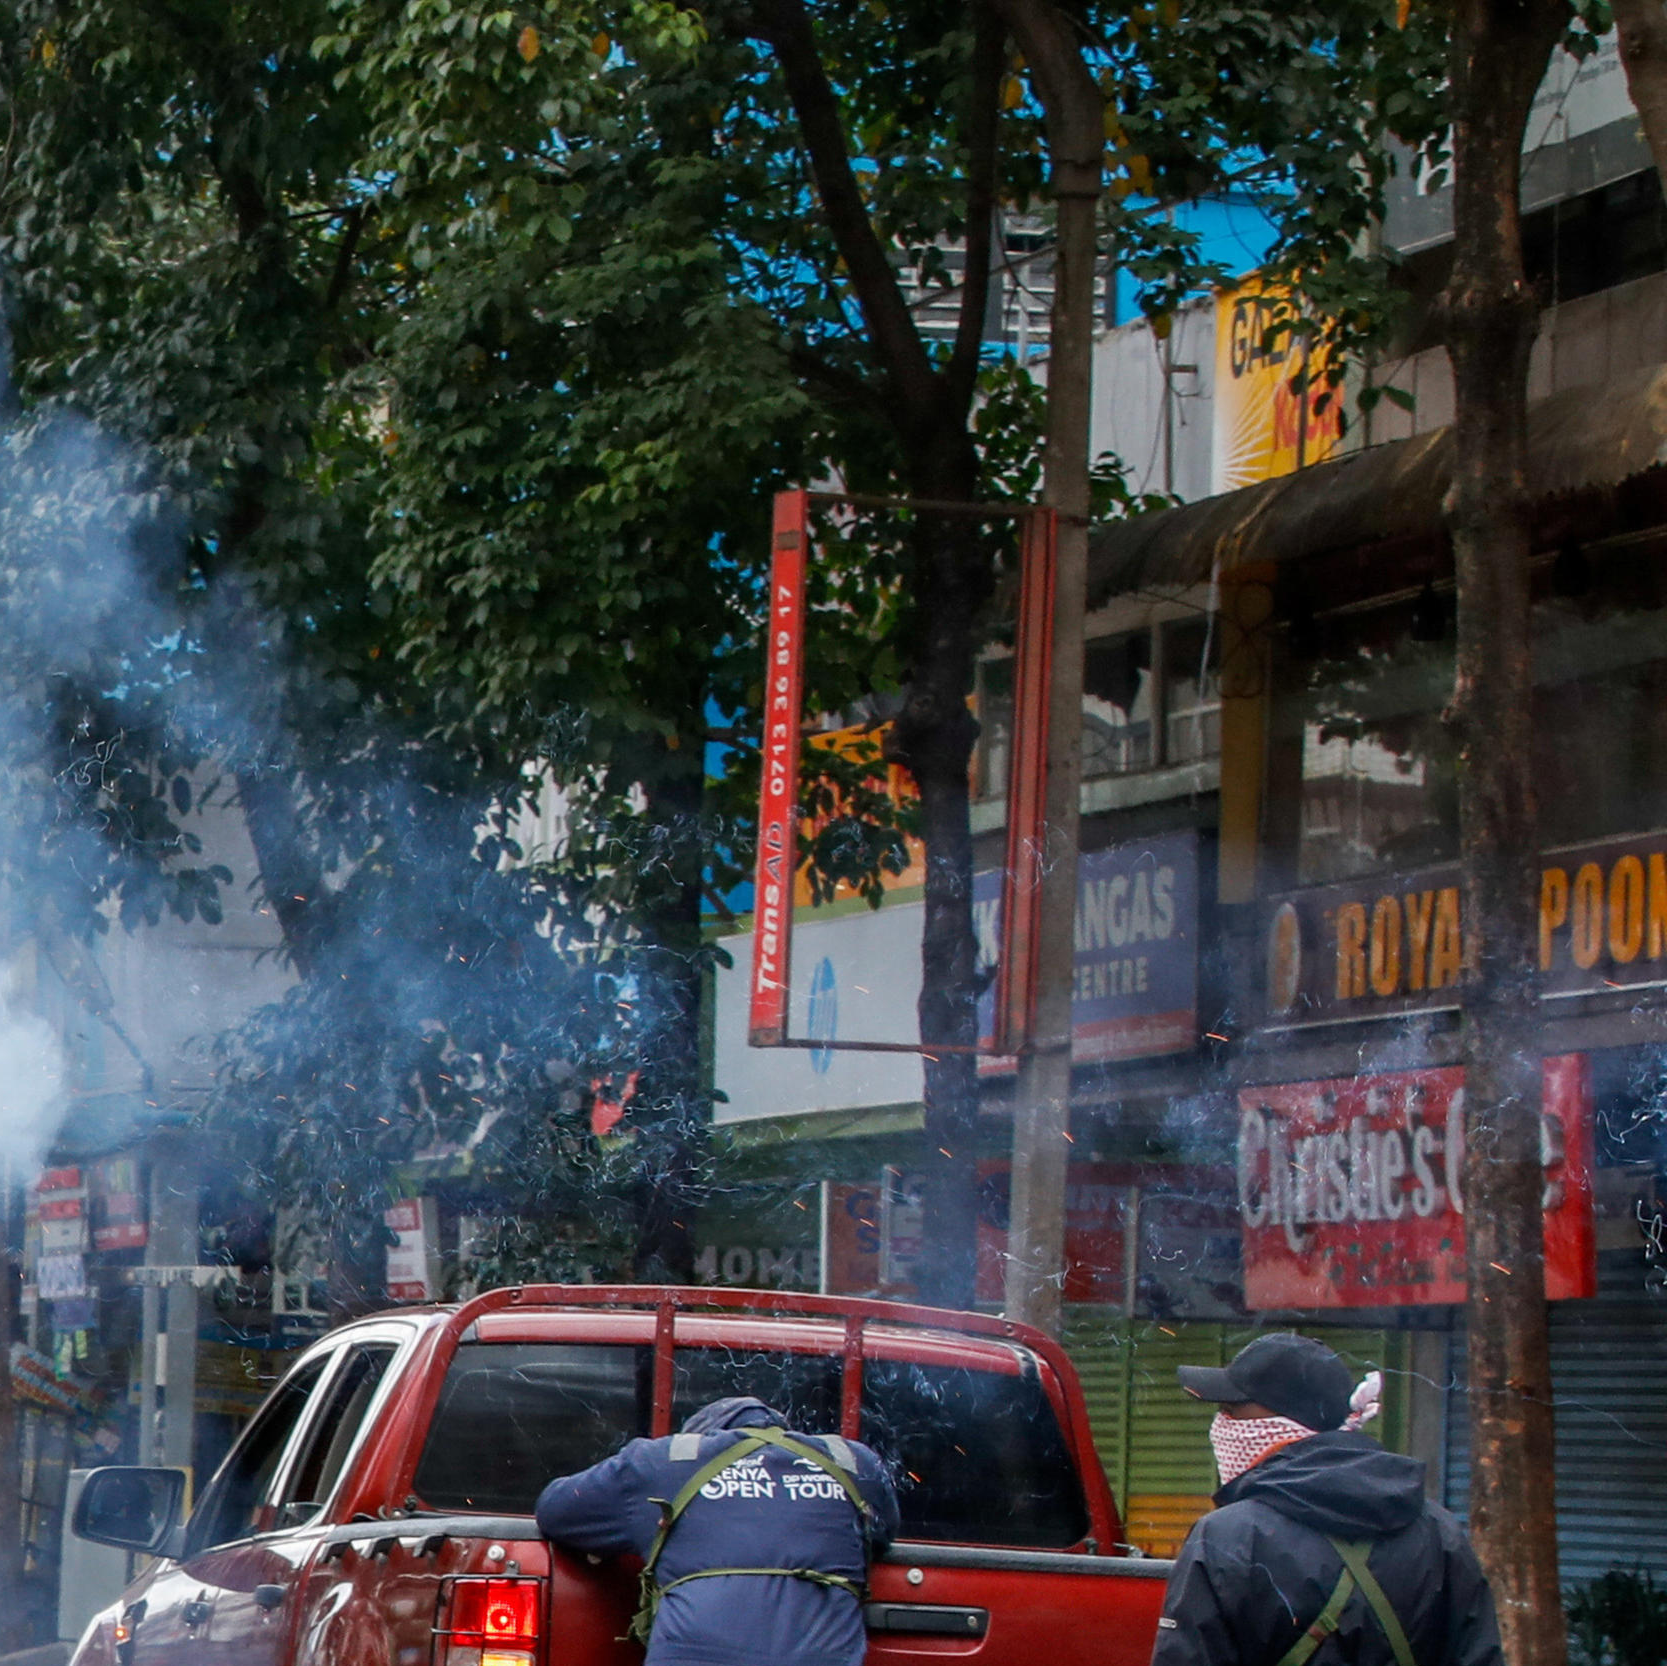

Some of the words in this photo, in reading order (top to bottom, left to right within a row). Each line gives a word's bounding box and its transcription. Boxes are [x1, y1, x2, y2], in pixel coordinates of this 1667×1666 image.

[777, 585, 792, 617] 17
[776, 631, 791, 666] 89
[773, 676, 789, 711] 36
[770, 723, 788, 796] 0713
[1335, 887, 1462, 999] ROYA
[1539, 852, 1667, 972] POO
[699, 1475, 776, 1500] OPEN
[721, 1467, 772, 1481] ENYA
[801, 1474, 837, 1483] WOR
[784, 1483, 847, 1501] TOUR
